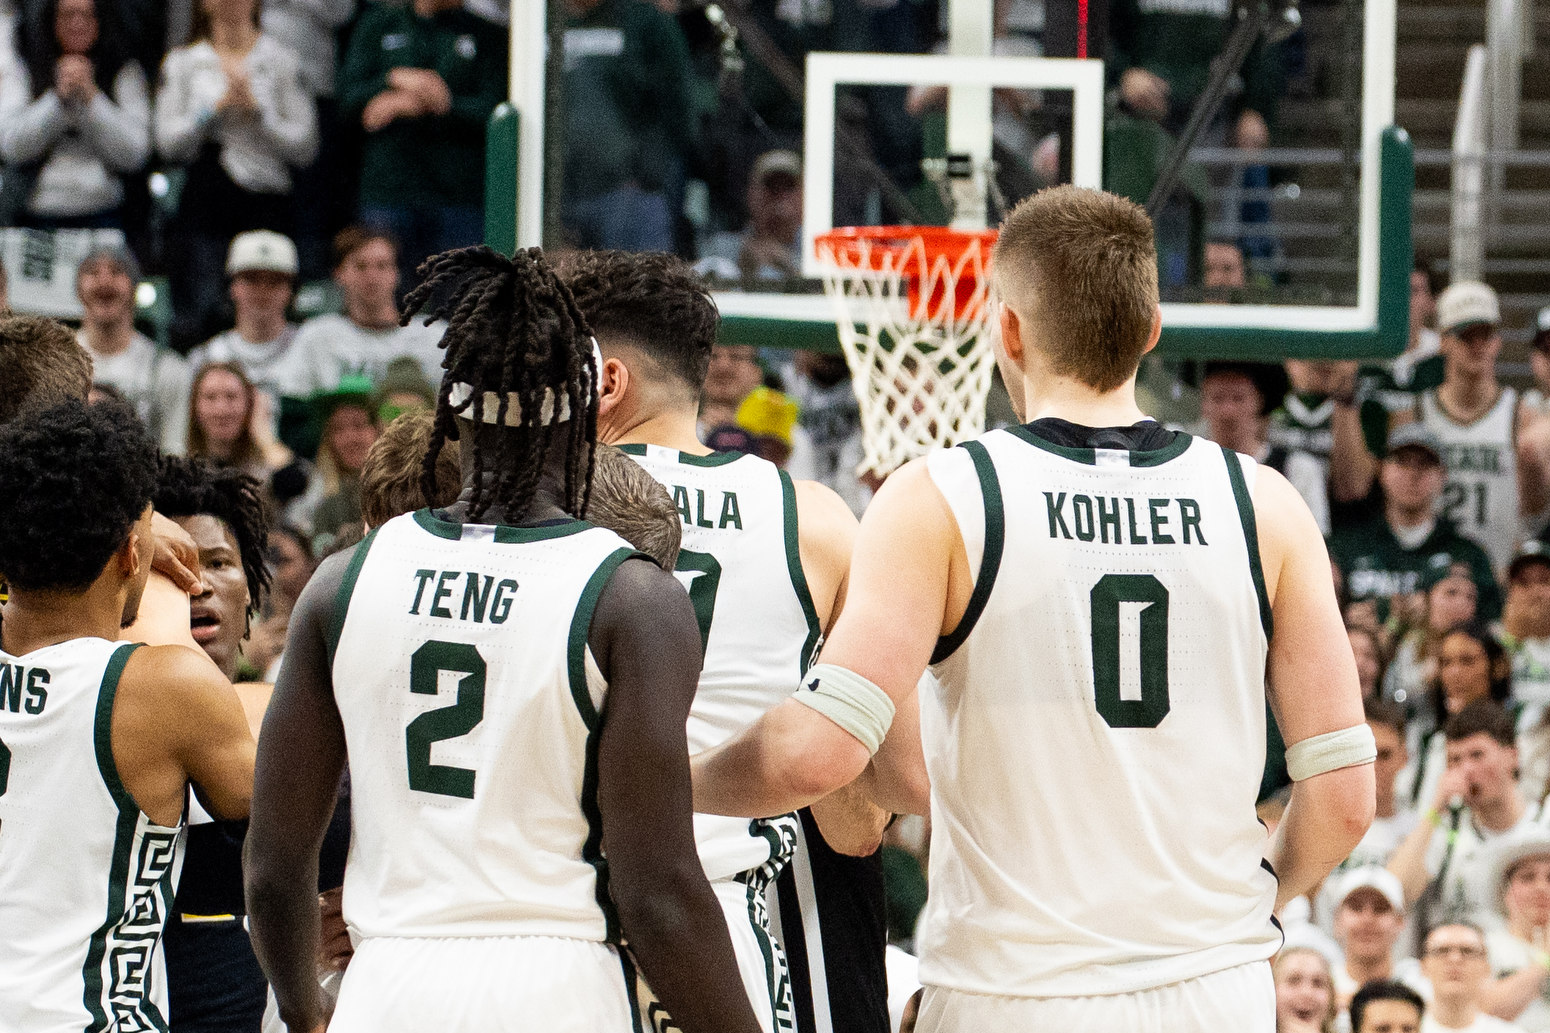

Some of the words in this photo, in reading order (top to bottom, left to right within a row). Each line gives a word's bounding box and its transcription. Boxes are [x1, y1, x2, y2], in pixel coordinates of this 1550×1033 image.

[1043, 490, 1209, 547] KOHLER
[407, 568, 519, 626] TENG
[1090, 573, 1170, 729] 0
[405, 639, 487, 800] 2
